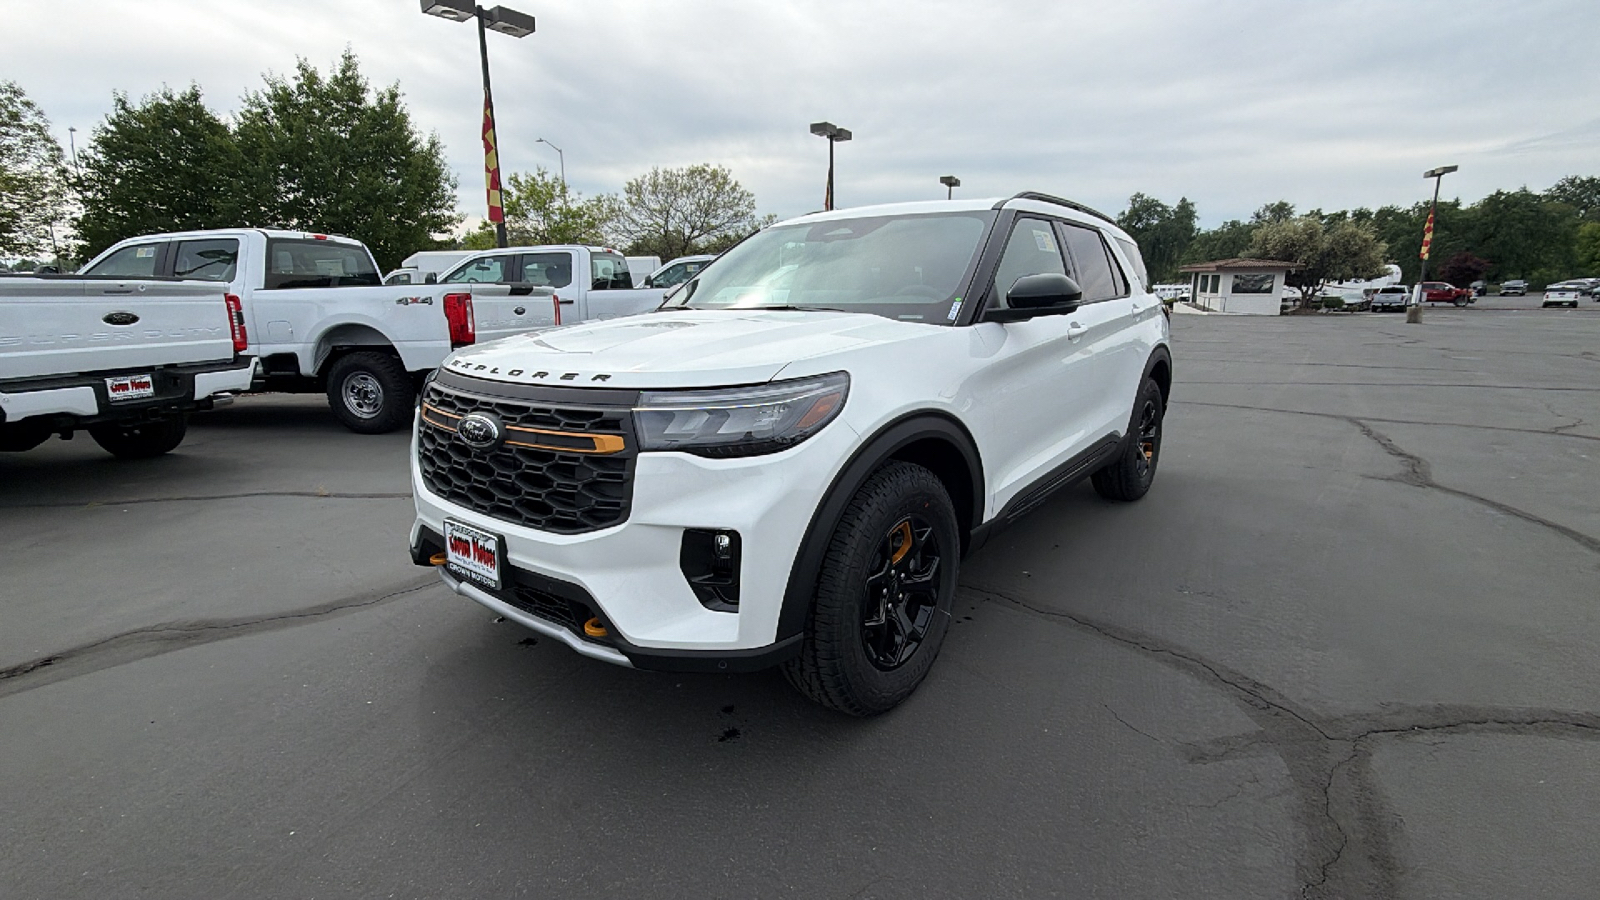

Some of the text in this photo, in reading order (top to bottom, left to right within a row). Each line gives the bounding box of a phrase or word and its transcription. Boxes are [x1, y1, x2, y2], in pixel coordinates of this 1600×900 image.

[0, 327, 220, 346] SUPER DUTY
[451, 359, 612, 382] EXPLORER
[449, 562, 471, 578] CROWN
[471, 572, 496, 588] MOTORS
